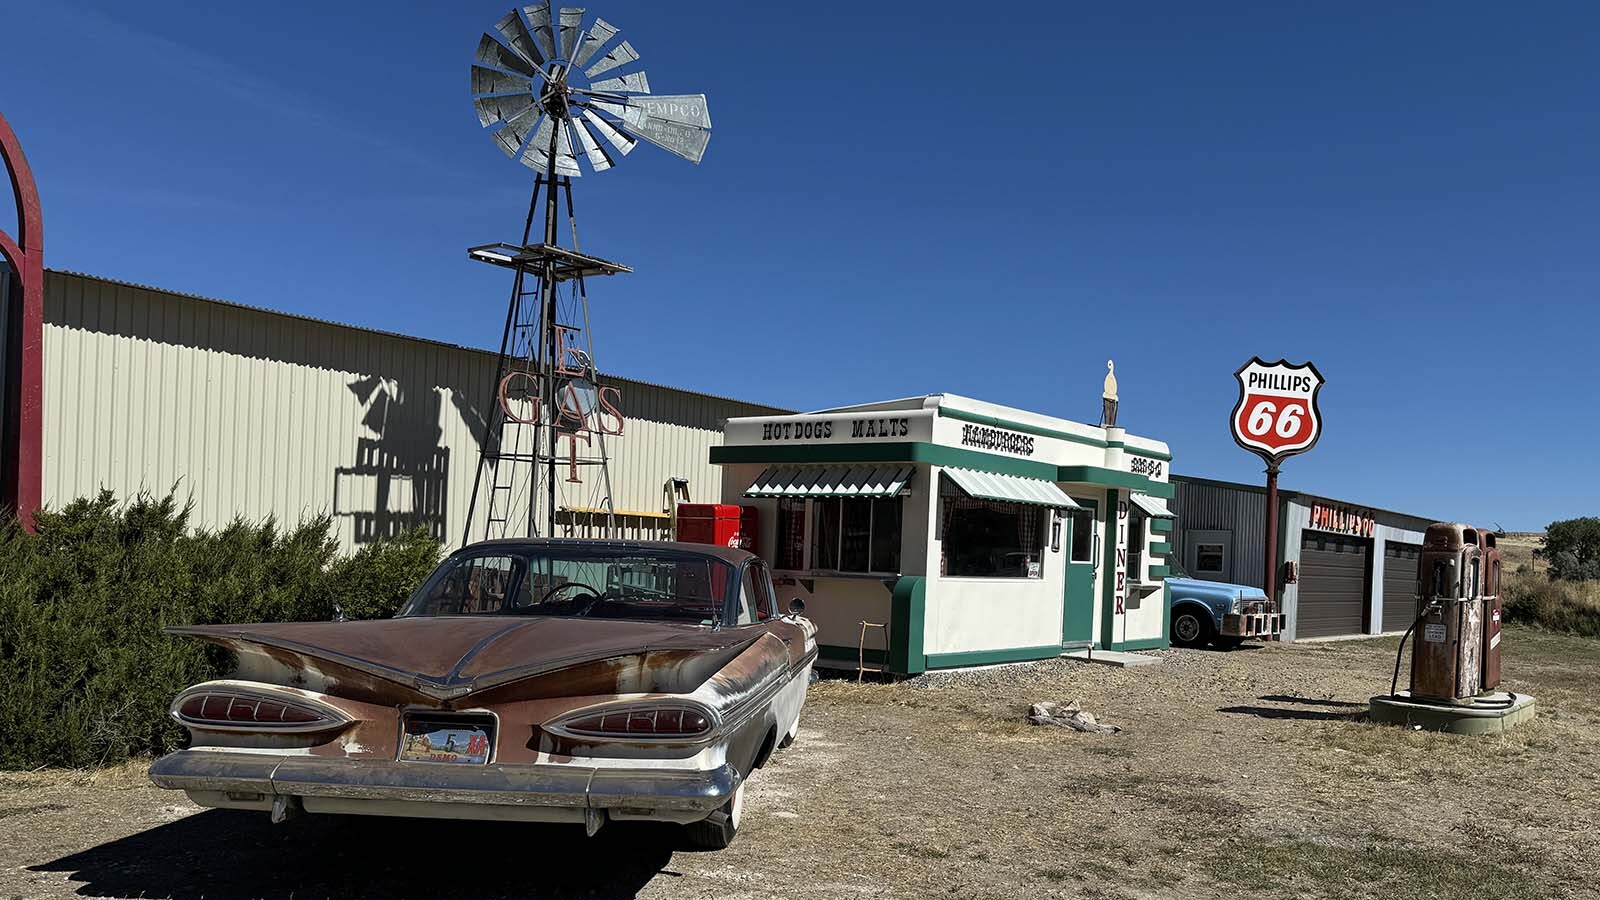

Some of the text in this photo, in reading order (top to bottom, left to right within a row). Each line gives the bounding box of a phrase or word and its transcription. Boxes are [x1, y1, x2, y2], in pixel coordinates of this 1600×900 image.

[1248, 372, 1311, 393] PHILLIPS
[498, 371, 624, 436] GAS
[1247, 401, 1305, 438] 66
[762, 418, 908, 440] HOT DOGS MALTS
[961, 424, 1034, 456] HAMBURGERS
[1114, 500, 1129, 615] DINER
